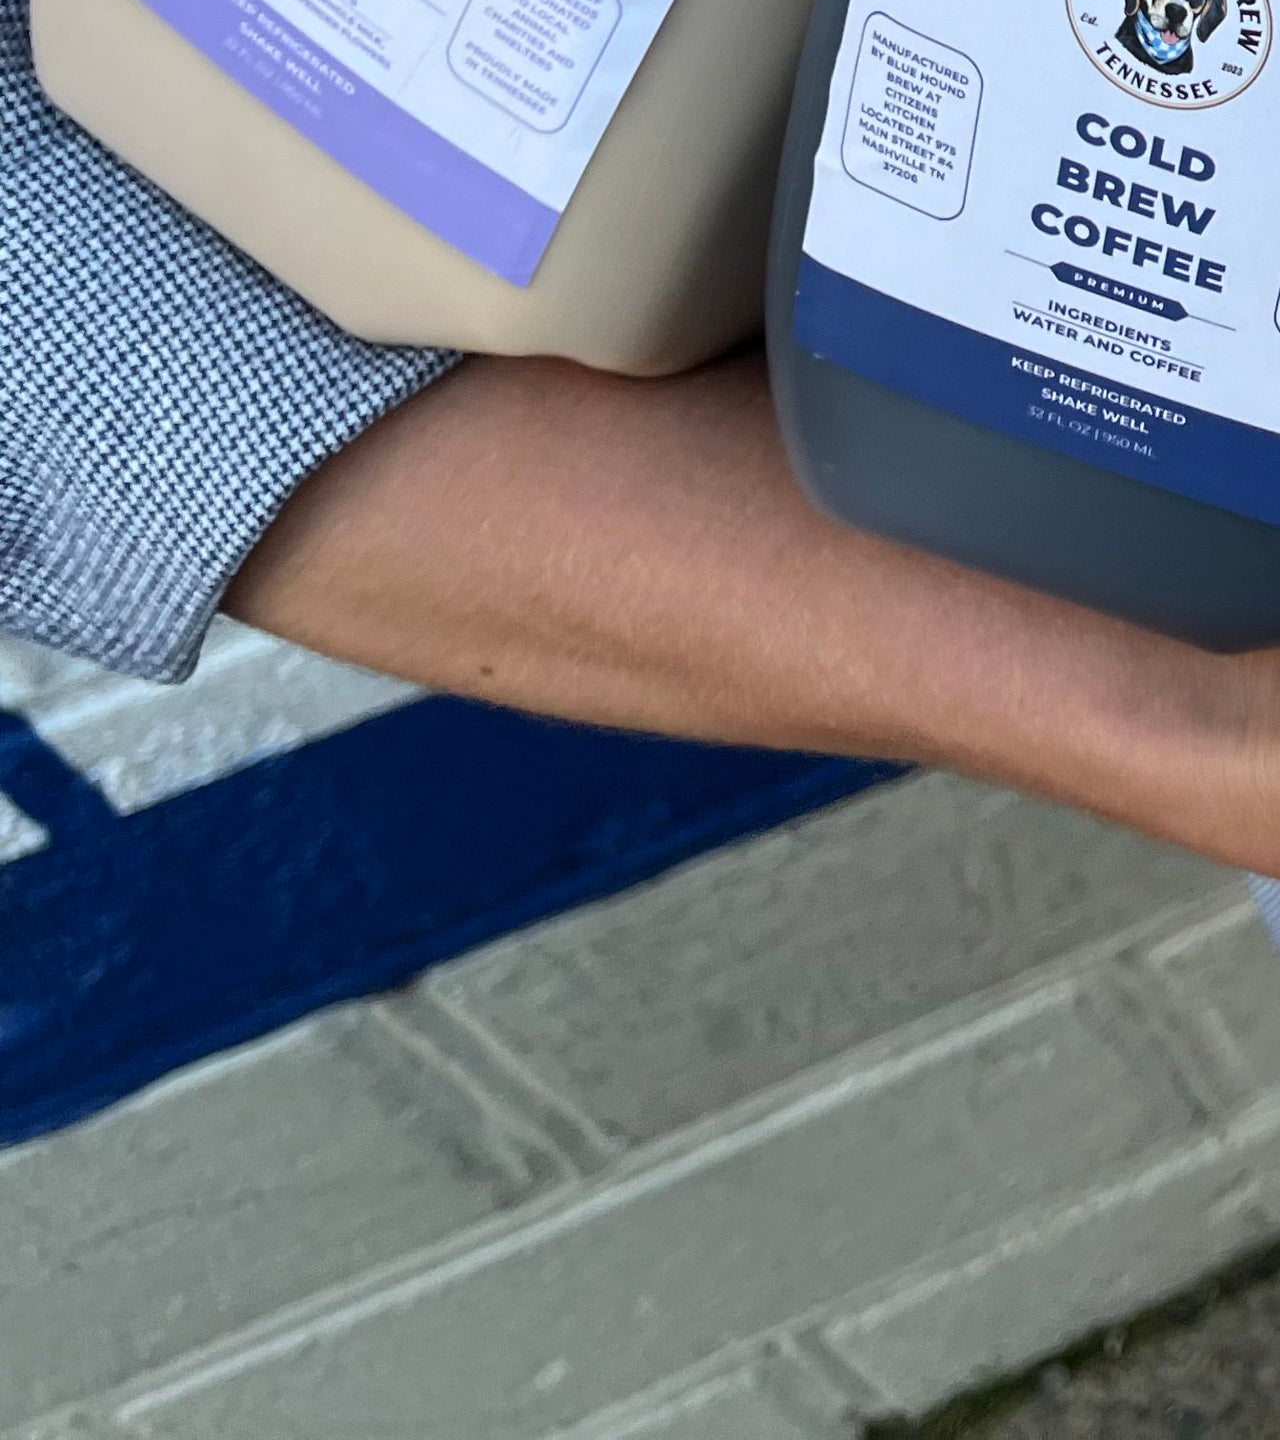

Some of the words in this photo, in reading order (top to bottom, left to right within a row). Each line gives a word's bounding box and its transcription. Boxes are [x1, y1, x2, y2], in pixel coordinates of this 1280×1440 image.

[1079, 12, 1098, 26] Est.
[1095, 41, 1218, 98] TENNESSEE
[1221, 62, 1244, 77] 2023
[1075, 112, 1215, 181] COLD
[1056, 156, 1216, 235] BREW
[1030, 203, 1226, 293] COFFEE
[1073, 272, 1163, 310] PREMIUM
[1013, 307, 1078, 340] WATER
[1083, 334, 1124, 355] AND
[1129, 350, 1201, 382] COFFEE
[1048, 299, 1170, 351] INGREDIENTS
[1011, 356, 1054, 378] KEEP
[1059, 373, 1185, 424] REFRIGERATED
[1041, 387, 1097, 415] SHAKE
[1102, 408, 1148, 433] WELL
